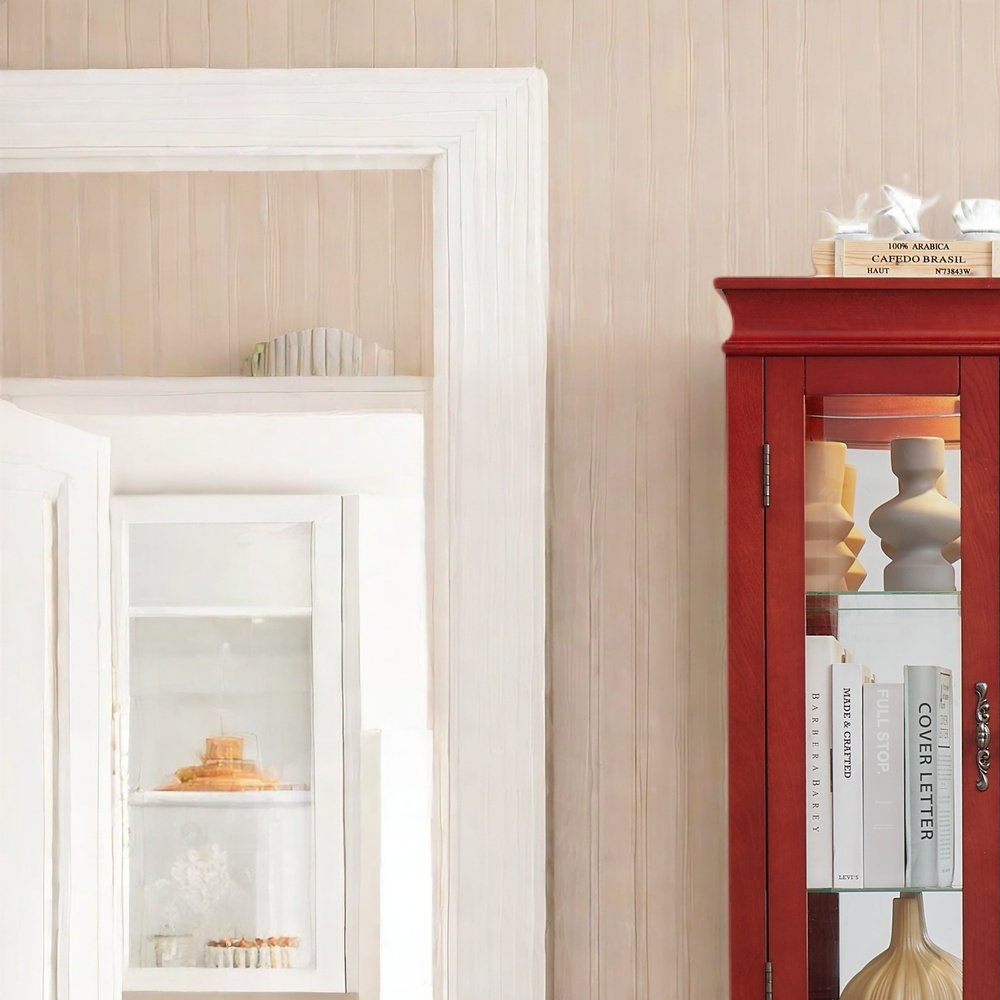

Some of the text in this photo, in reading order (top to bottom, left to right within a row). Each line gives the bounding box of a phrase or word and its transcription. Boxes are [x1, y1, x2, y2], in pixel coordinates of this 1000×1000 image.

[923, 255, 966, 264] BRASIL
[843, 687, 852, 779] MADE & CRAFTED
[876, 689, 889, 728] FULL
[918, 703, 934, 840] COVER LETTER
